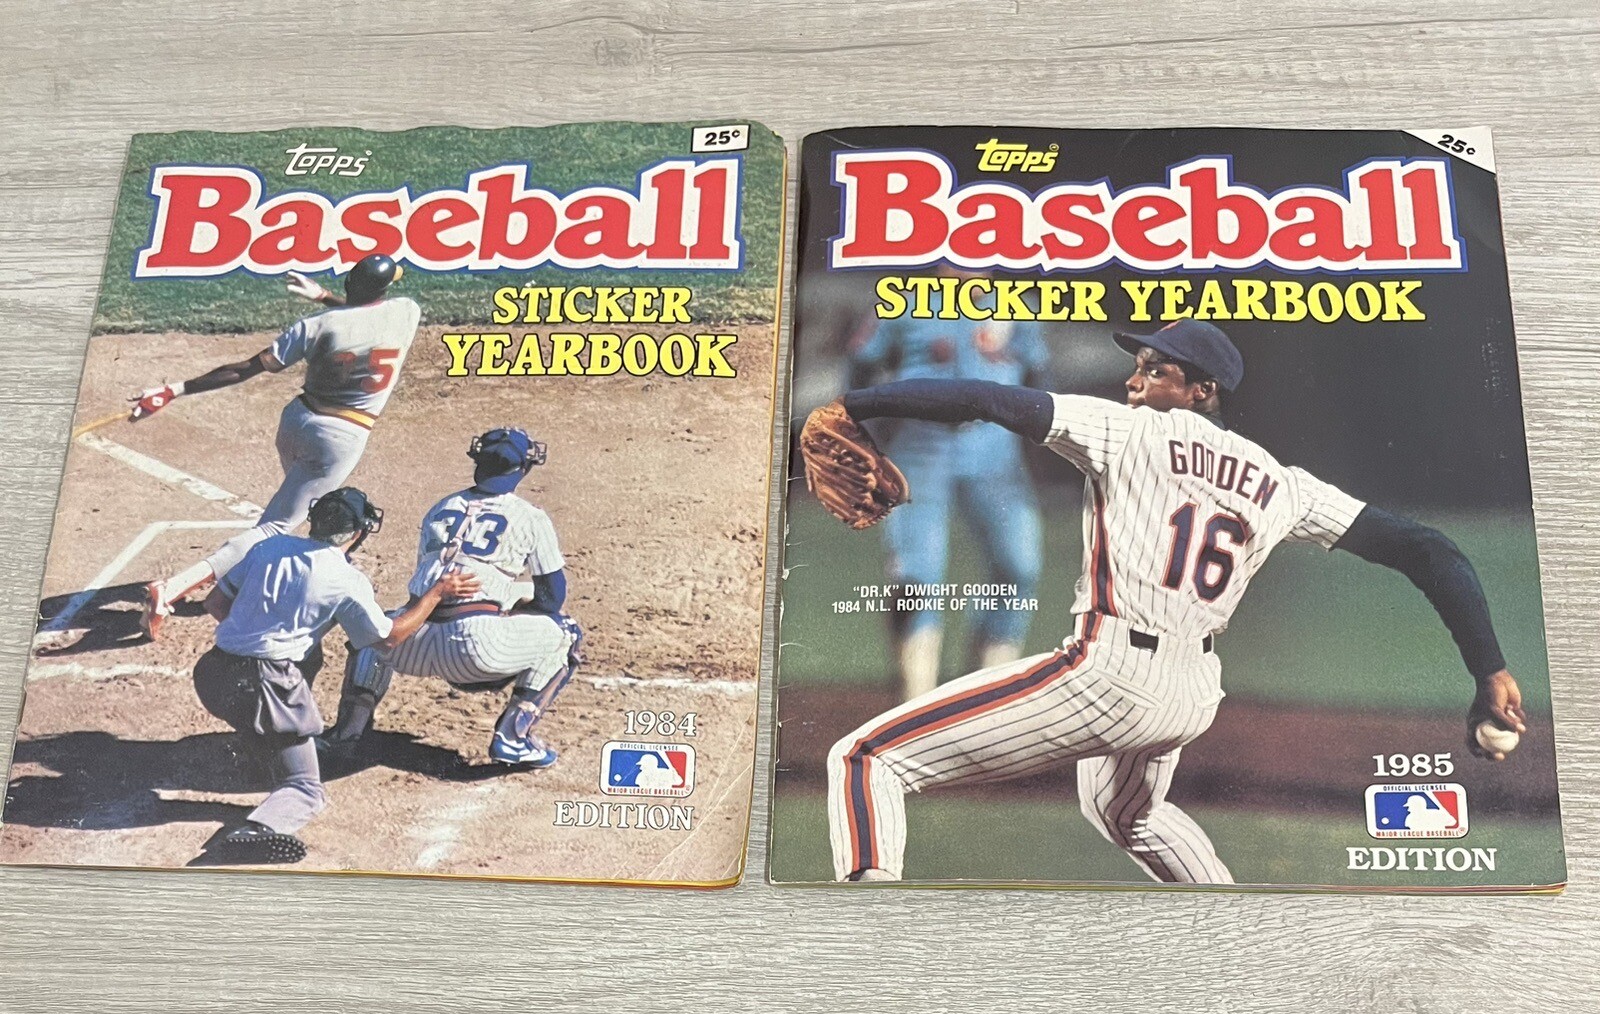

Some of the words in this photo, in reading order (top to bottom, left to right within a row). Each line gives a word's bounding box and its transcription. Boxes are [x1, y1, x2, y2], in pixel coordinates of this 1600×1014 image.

[143, 165, 735, 270] Baseball
[840, 158, 1454, 263] Baseball
[491, 285, 694, 325] STICKER
[875, 276, 1109, 322] STICKER
[1121, 278, 1426, 323] YEARBOOK
[442, 332, 739, 379] YEARBOOK
[1168, 439, 1280, 512] GOODEN
[1159, 502, 1252, 604] 16
[831, 600, 861, 614] 1984
[865, 599, 891, 612] N.L.
[896, 598, 945, 612] ROOKIE
[950, 598, 968, 611] OF
[972, 598, 999, 611] THE
[1004, 598, 1039, 611] YEAR
[905, 584, 959, 598] DWIGHT
[963, 583, 1018, 597] GOODEN
[623, 709, 697, 738] 1984
[1372, 752, 1455, 777] 1985
[552, 800, 696, 831] EDITION
[1345, 846, 1498, 872] EDITION
